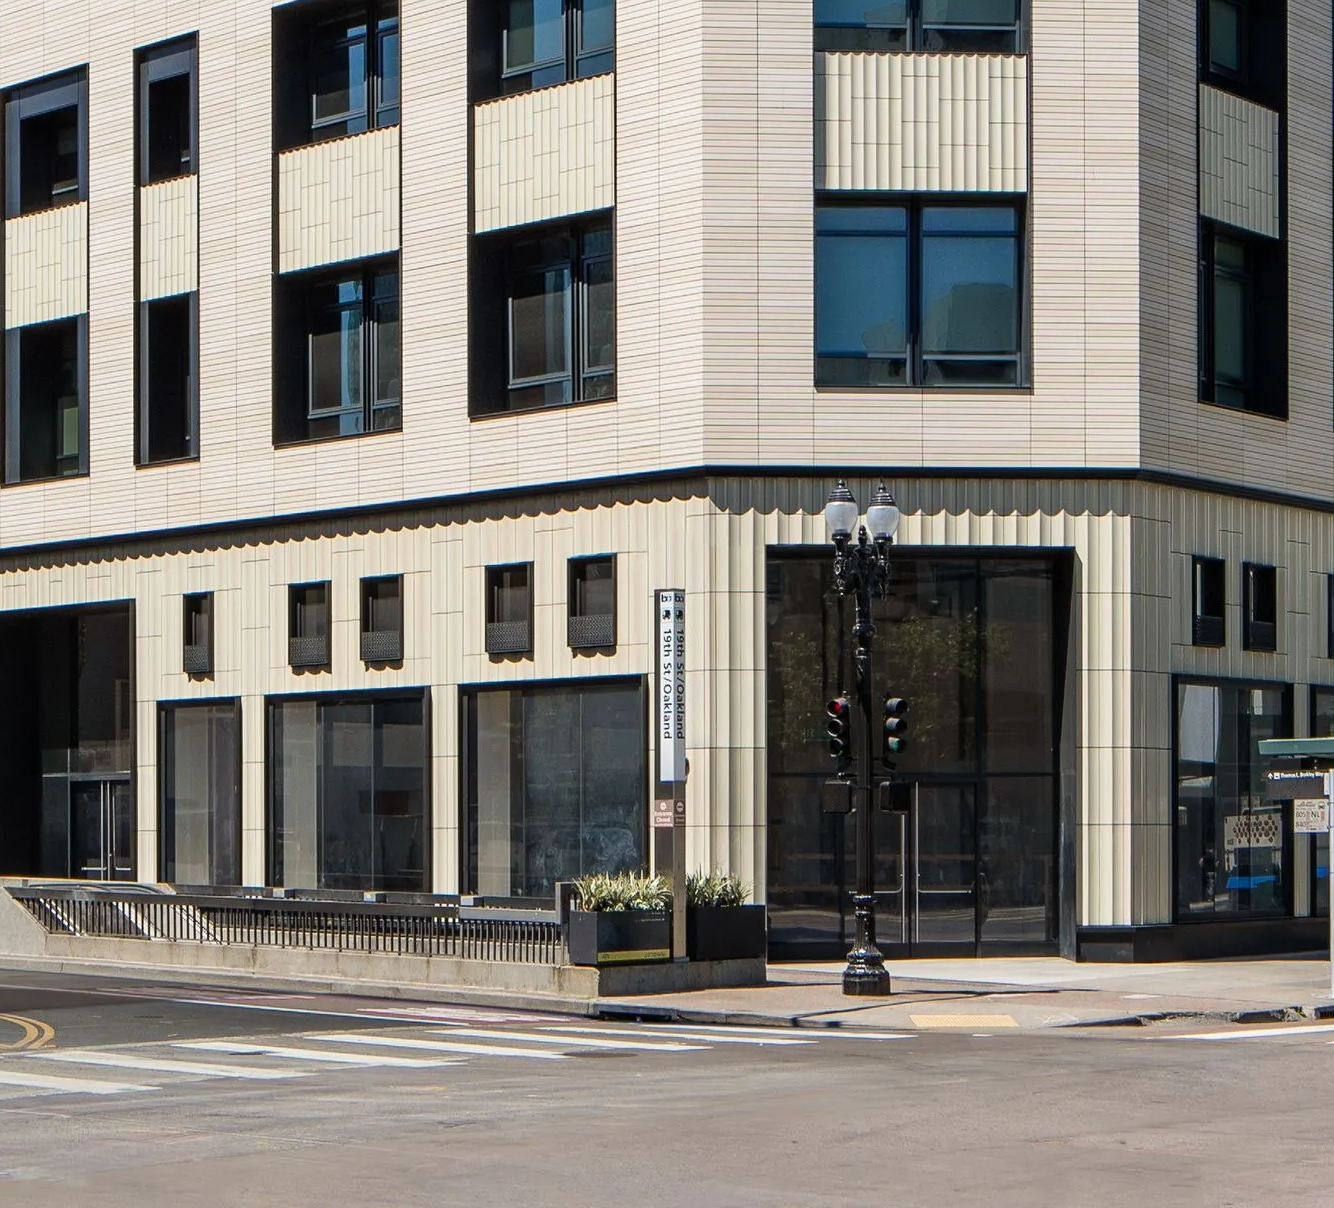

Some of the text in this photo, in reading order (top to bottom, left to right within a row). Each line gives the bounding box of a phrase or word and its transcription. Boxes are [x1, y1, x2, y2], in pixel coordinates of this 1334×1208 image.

[676, 629, 685, 658] 19th
[663, 628, 673, 740] 19th St/Oakland
